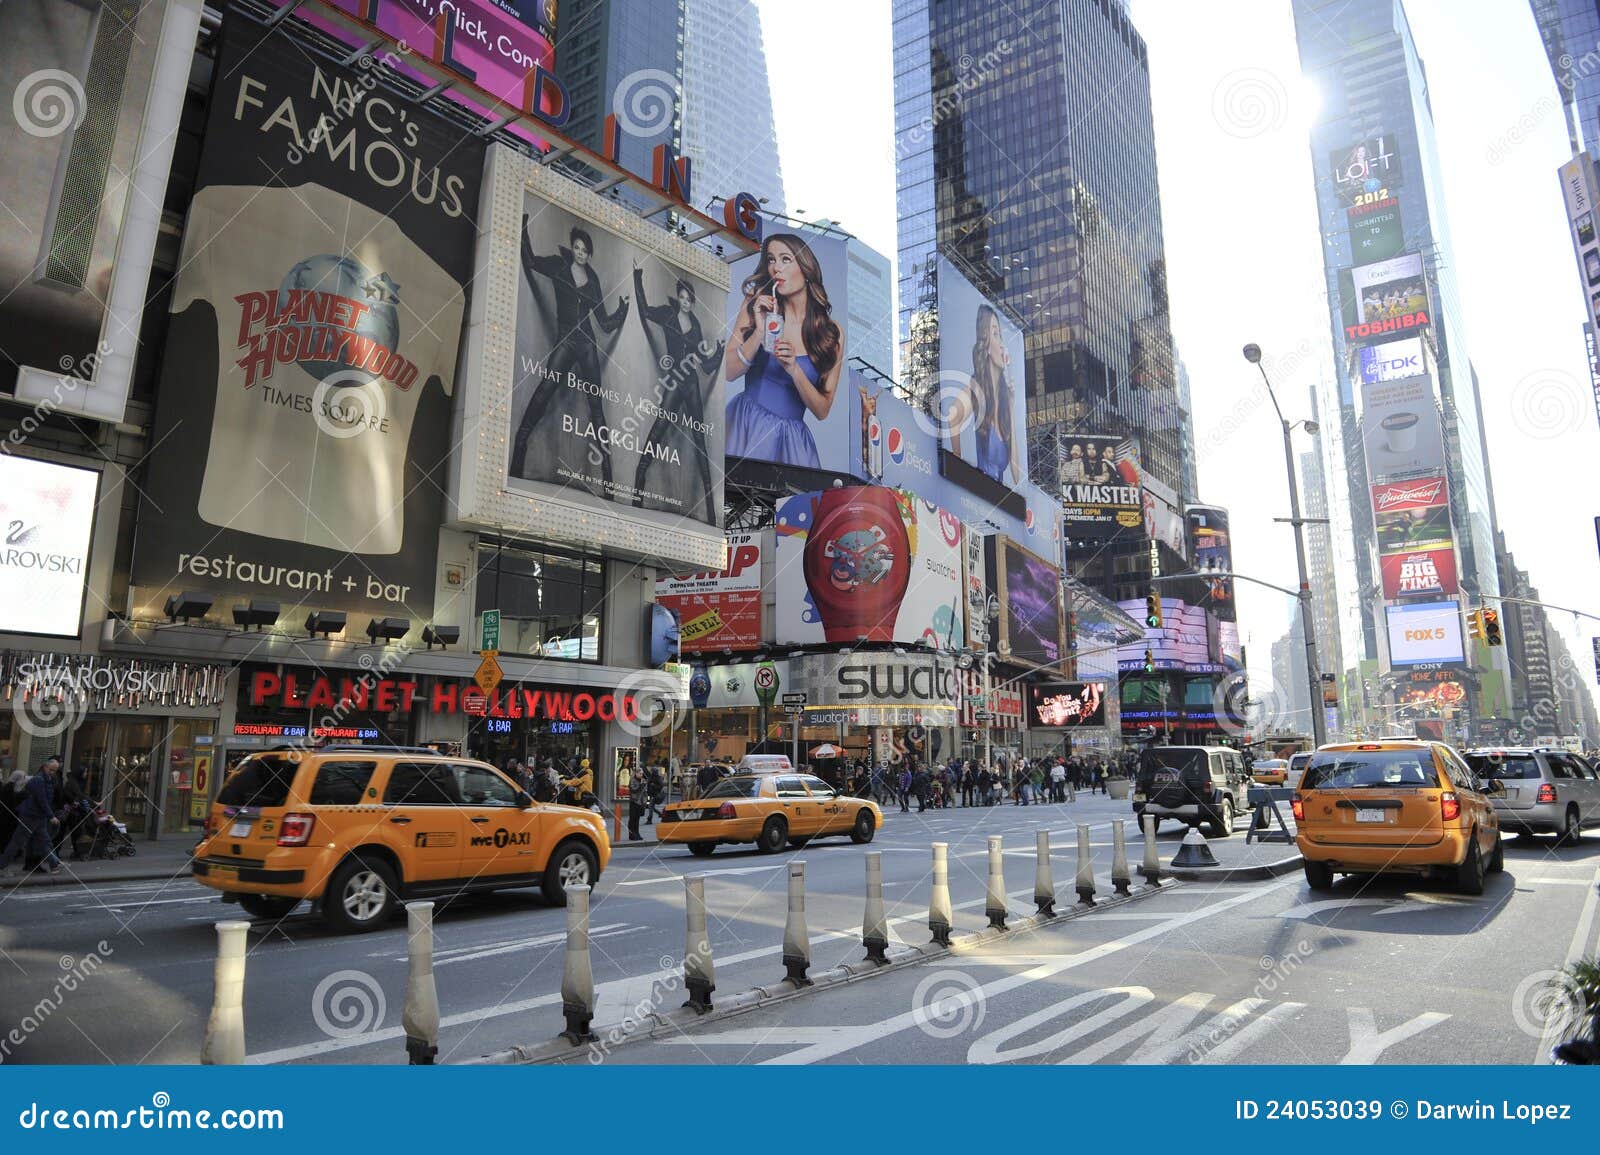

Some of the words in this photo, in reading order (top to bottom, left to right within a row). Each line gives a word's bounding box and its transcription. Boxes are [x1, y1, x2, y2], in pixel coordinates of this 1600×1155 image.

[310, 65, 420, 147] NYC's
[234, 75, 465, 217] FAMOUS
[1335, 152, 1394, 184] LOFT
[1354, 188, 1389, 207] 2012
[234, 290, 370, 344] PLANET
[1345, 311, 1429, 340] TOSHIBA
[235, 321, 420, 392] HOLLYWOOD
[1380, 354, 1418, 372] TDK
[262, 384, 313, 414] TIMES
[318, 401, 391, 434] SQUARE
[624, 393, 634, 408] A
[562, 414, 681, 466] BLACKGLAMA
[1076, 485, 1140, 504] MASTER
[1376, 488, 1441, 504] Budweiser
[731, 536, 739, 544] IT
[740, 535, 751, 544] UP
[0, 549, 81, 574] ROVSKI
[1151, 539, 1160, 577] 1500
[178, 552, 333, 594] restaurant
[366, 569, 410, 604] bar
[1400, 561, 1437, 579] BIG
[1400, 576, 1441, 593] TIME
[1404, 628, 1434, 642] FOX
[1435, 627, 1446, 640] 5
[1412, 662, 1444, 670] SONY
[18, 663, 169, 693] SWAROVSKI
[1410, 672, 1431, 681] HOME
[253, 671, 417, 713] PLANET
[1043, 697, 1055, 705] Do
[1055, 694, 1072, 702] You
[434, 683, 638, 721] HOLLYWOOD
[487, 720, 494, 732] &
[495, 720, 512, 733] BAR
[811, 711, 850, 724] swatch
[235, 725, 282, 736] RESTAURANT
[290, 727, 306, 737] BAR
[314, 727, 358, 738] RESTAURANT
[365, 730, 379, 738] BAR
[558, 722, 573, 734] BAR
[470, 836, 492, 847] NYC
[493, 827, 531, 848] TAXI
